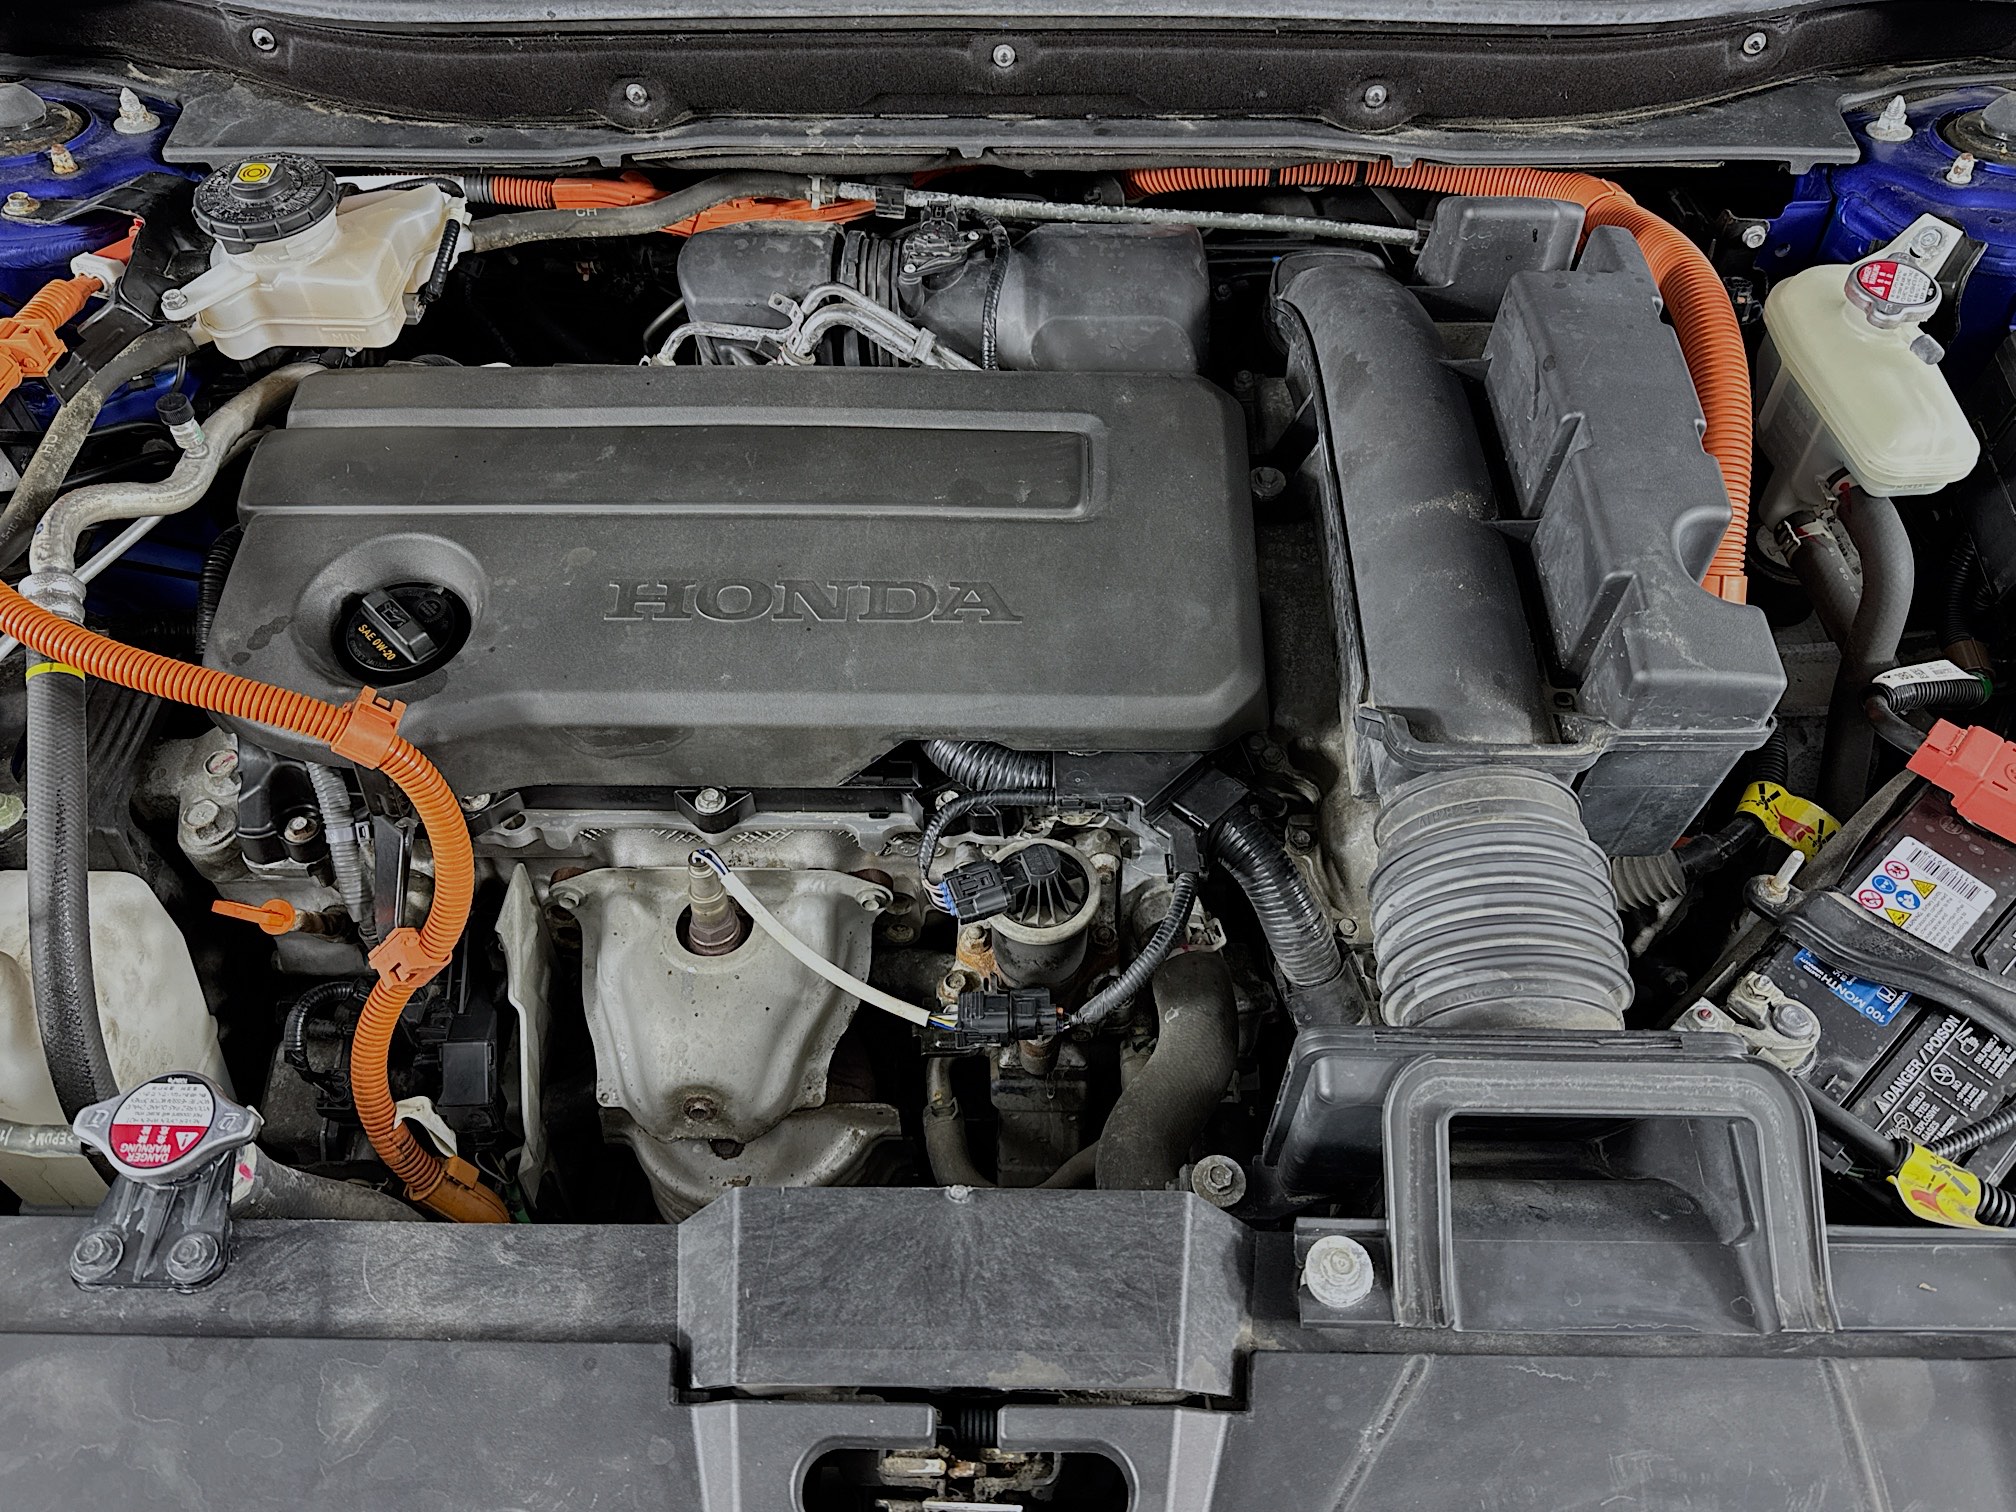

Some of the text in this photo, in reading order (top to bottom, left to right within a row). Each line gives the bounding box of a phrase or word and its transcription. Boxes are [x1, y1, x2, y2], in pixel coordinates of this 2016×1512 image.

[331, 332, 361, 343] MIN
[39, 433, 58, 455] CH
[603, 578, 1024, 624] HONDA
[358, 624, 396, 662] SAE 0W-20
[1799, 956, 1824, 975] WARRANTY
[1803, 964, 1821, 978] LIMITED
[1820, 973, 1866, 1009] MONTH
[1887, 992, 1909, 1013] HONDA
[1865, 1004, 1887, 1023] 100
[1883, 1057, 1924, 1104] DANGER
[1924, 1014, 1961, 1056] POISON
[1951, 1079, 1963, 1091] NO
[1906, 1090, 1927, 1113] SHIELD
[1914, 1101, 1930, 1118] EYES
[1912, 1104, 1940, 1136] EXPLOSIVE
[1920, 1120, 1940, 1141] GASES
[120, 1143, 171, 1153] WARNUNG
[127, 1153, 168, 1162] DANGER
